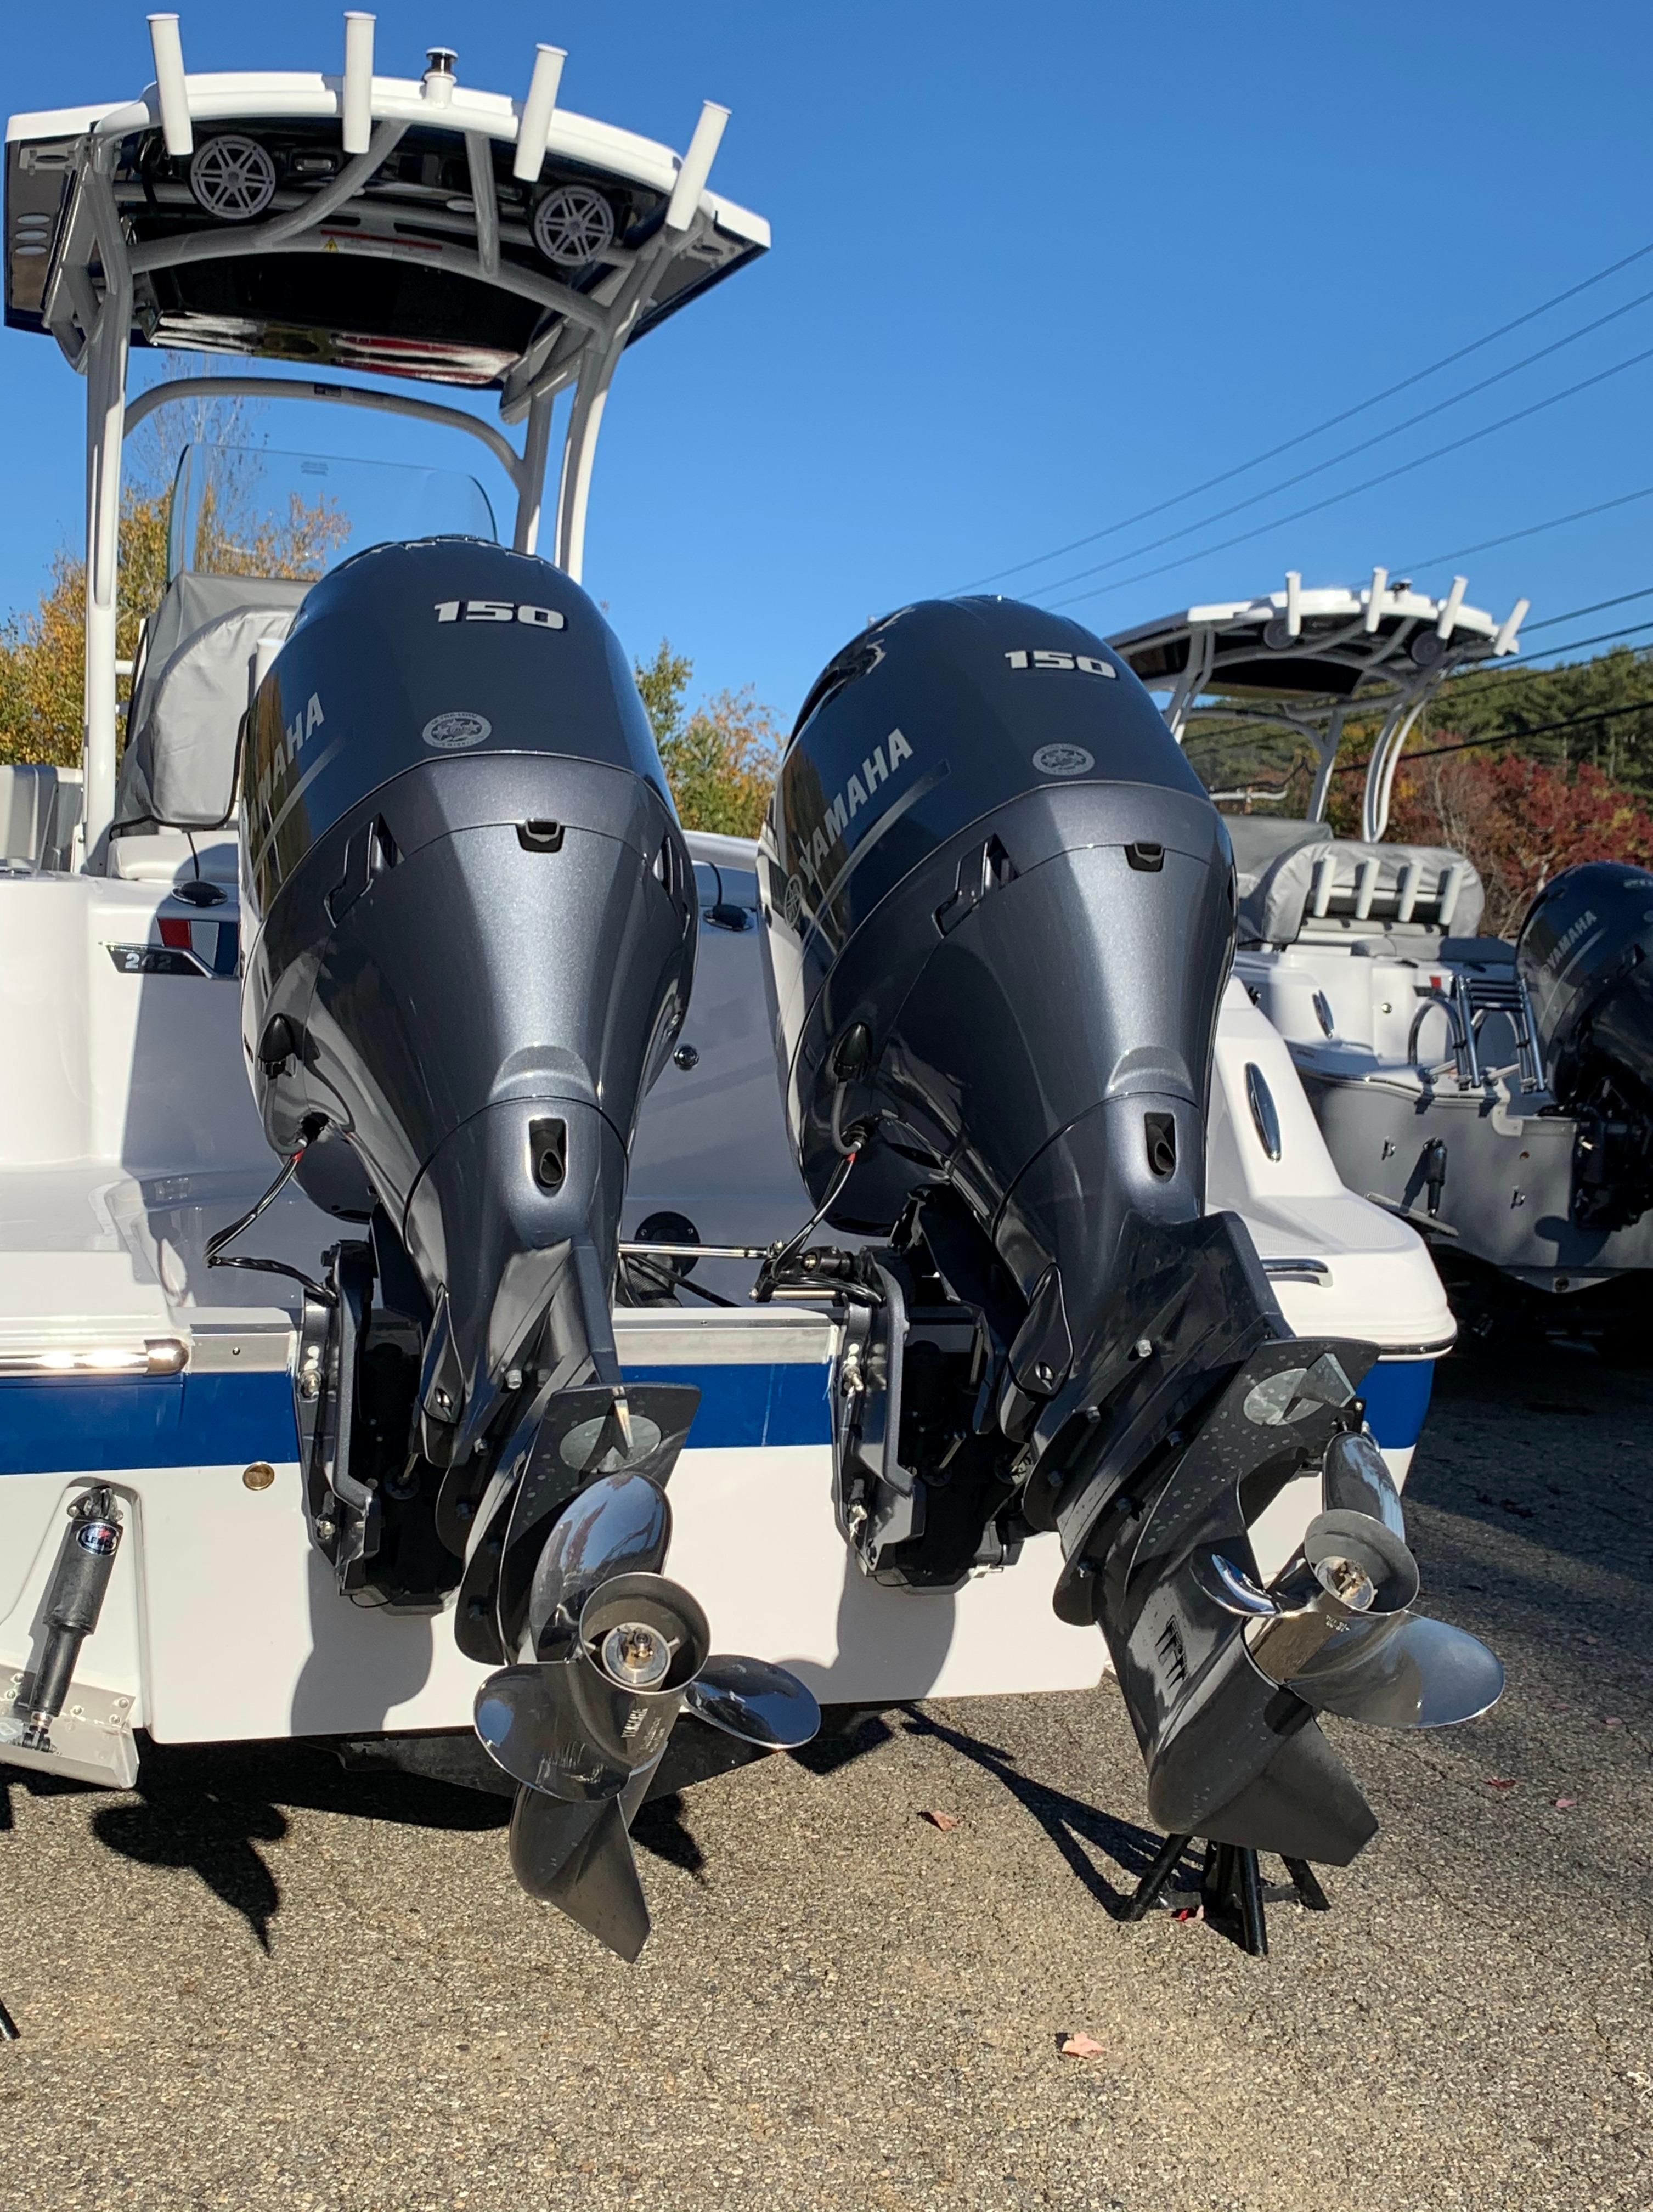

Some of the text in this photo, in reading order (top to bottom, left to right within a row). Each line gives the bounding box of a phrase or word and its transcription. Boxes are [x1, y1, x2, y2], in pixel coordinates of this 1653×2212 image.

[434, 601, 564, 630] 150
[1005, 650, 1116, 679] 150
[243, 692, 325, 846] AMAHA
[799, 727, 913, 885] YAMAHA
[124, 953, 172, 970] 242
[1546, 910, 1598, 970] YAMAHA
